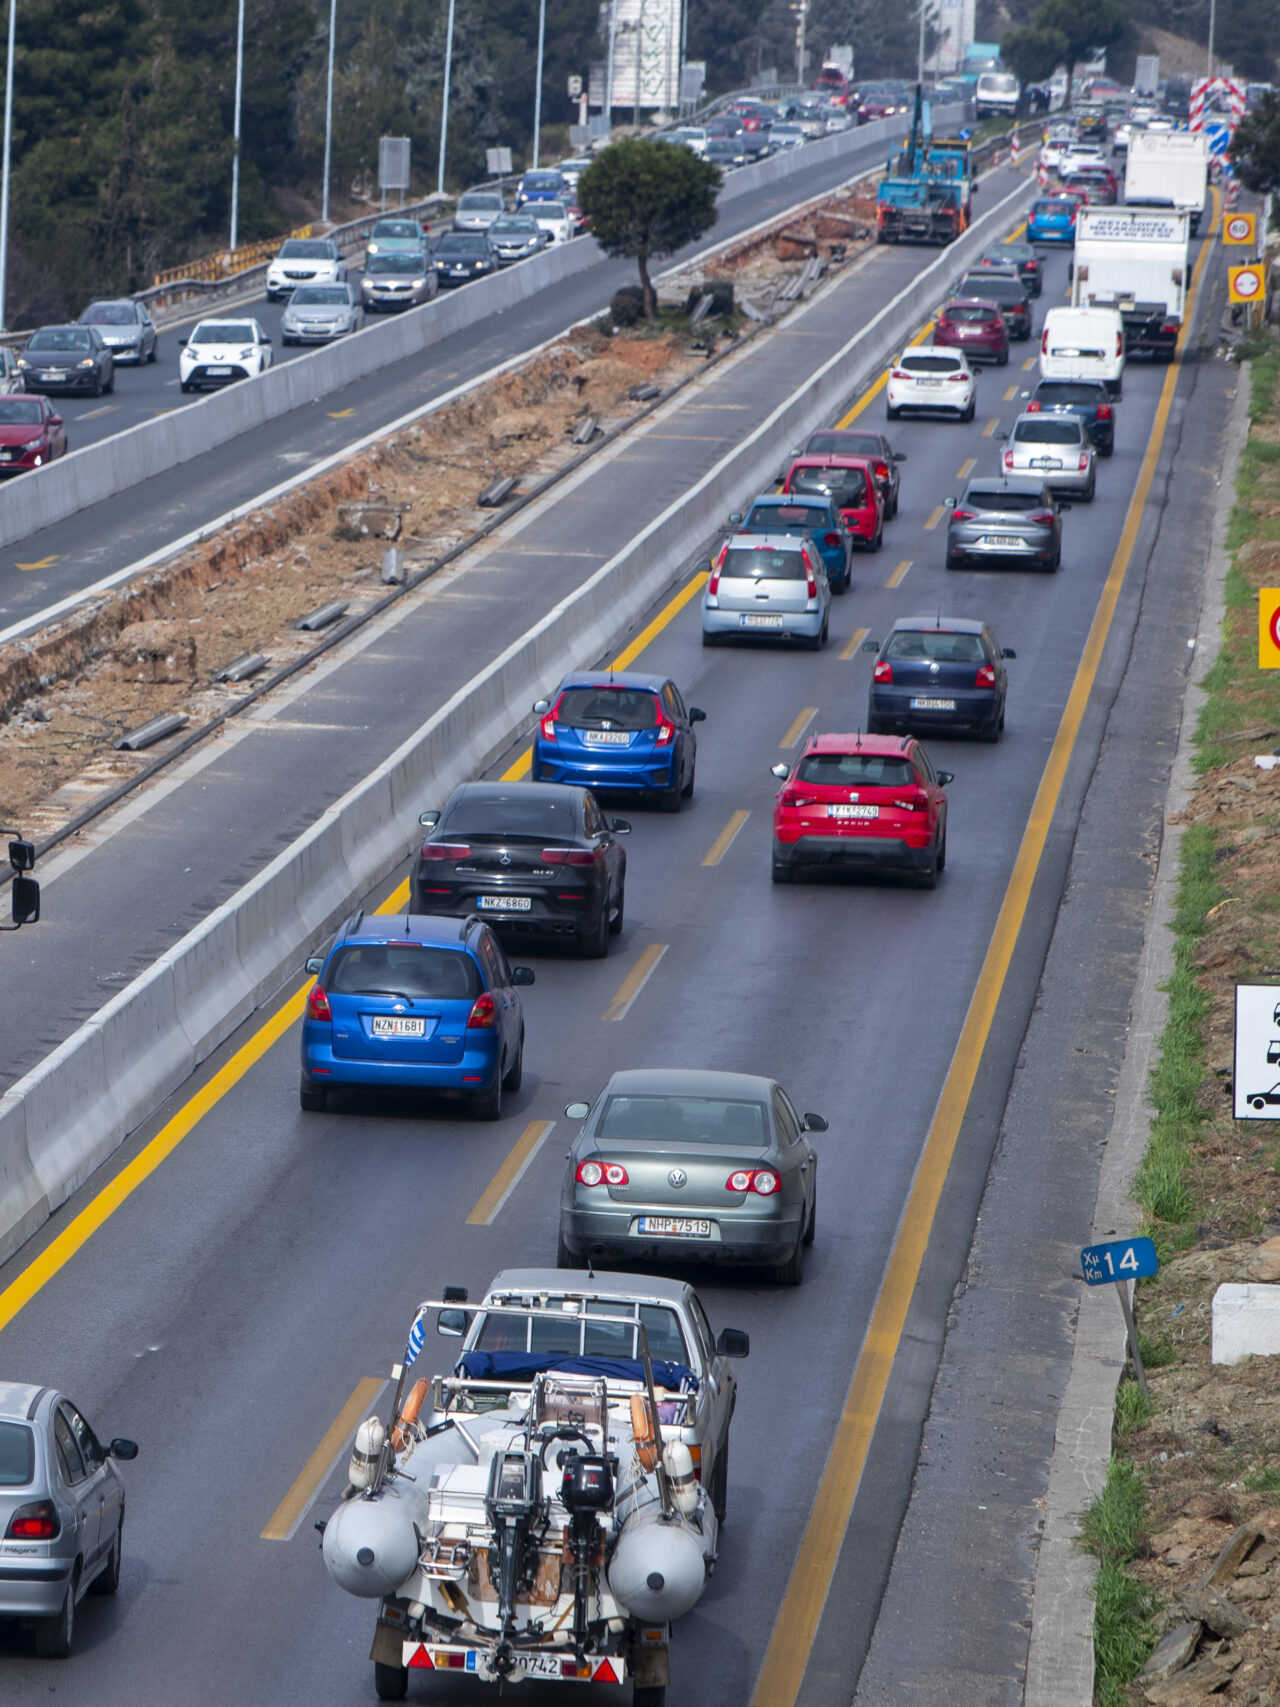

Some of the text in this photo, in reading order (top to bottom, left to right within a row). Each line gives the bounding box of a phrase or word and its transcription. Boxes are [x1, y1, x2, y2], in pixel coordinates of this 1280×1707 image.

[1231, 224, 1246, 234] 60
[1104, 1247, 1139, 1276] 14
[1085, 1268, 1103, 1281] Km
